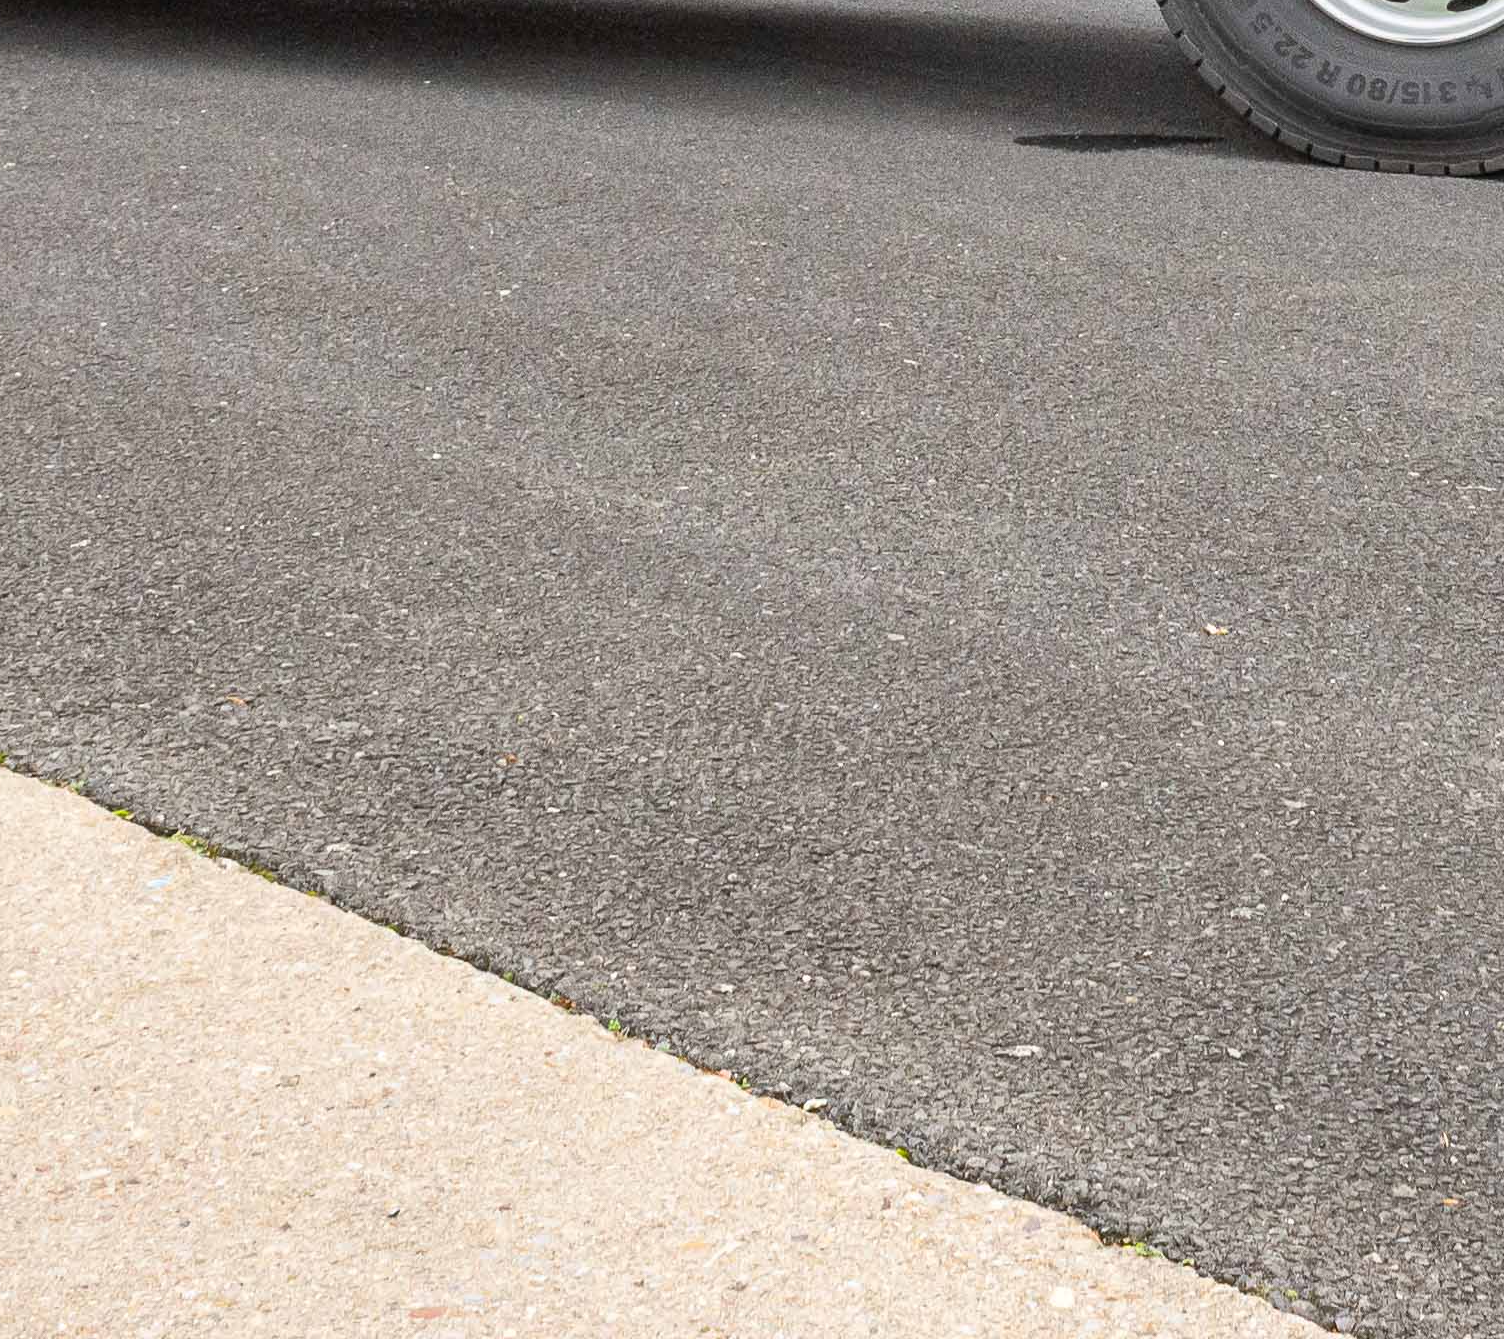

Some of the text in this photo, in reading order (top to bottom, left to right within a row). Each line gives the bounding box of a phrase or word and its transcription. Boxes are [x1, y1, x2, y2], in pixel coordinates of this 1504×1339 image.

[1253, 13, 1457, 105] 315/80 R 22.5
